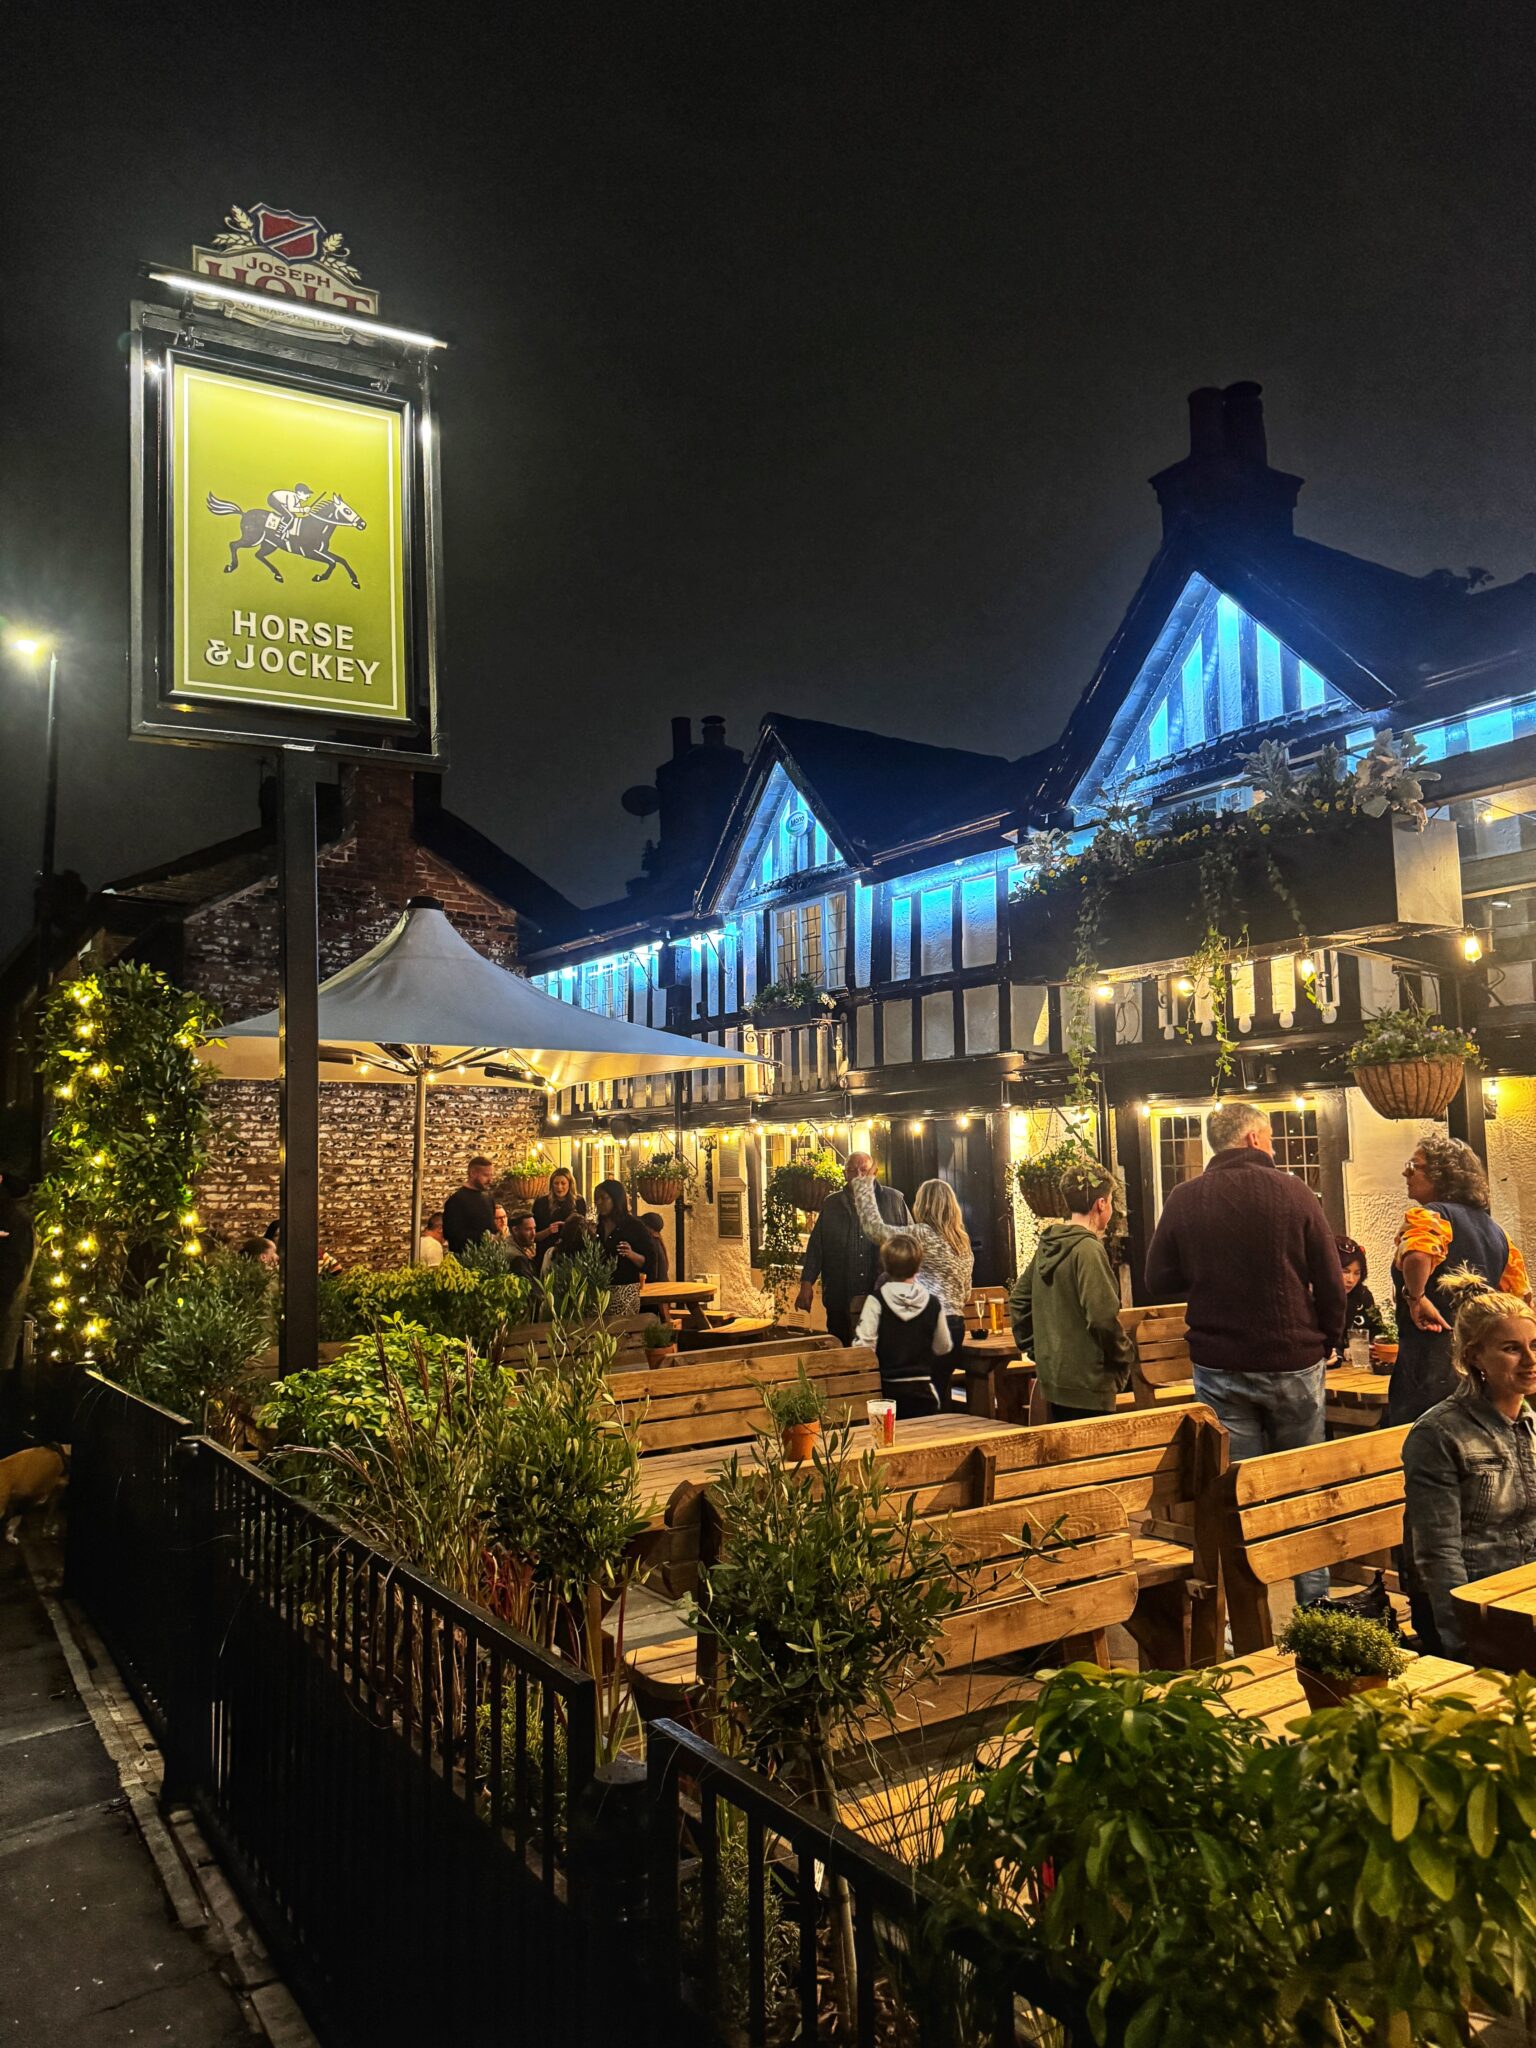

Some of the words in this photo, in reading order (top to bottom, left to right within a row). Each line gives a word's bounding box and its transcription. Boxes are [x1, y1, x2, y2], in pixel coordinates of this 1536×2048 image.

[246, 256, 331, 289] JOSEPH
[232, 609, 354, 651] HORSE
[205, 638, 232, 666] &
[235, 643, 380, 686] JOCKEY
